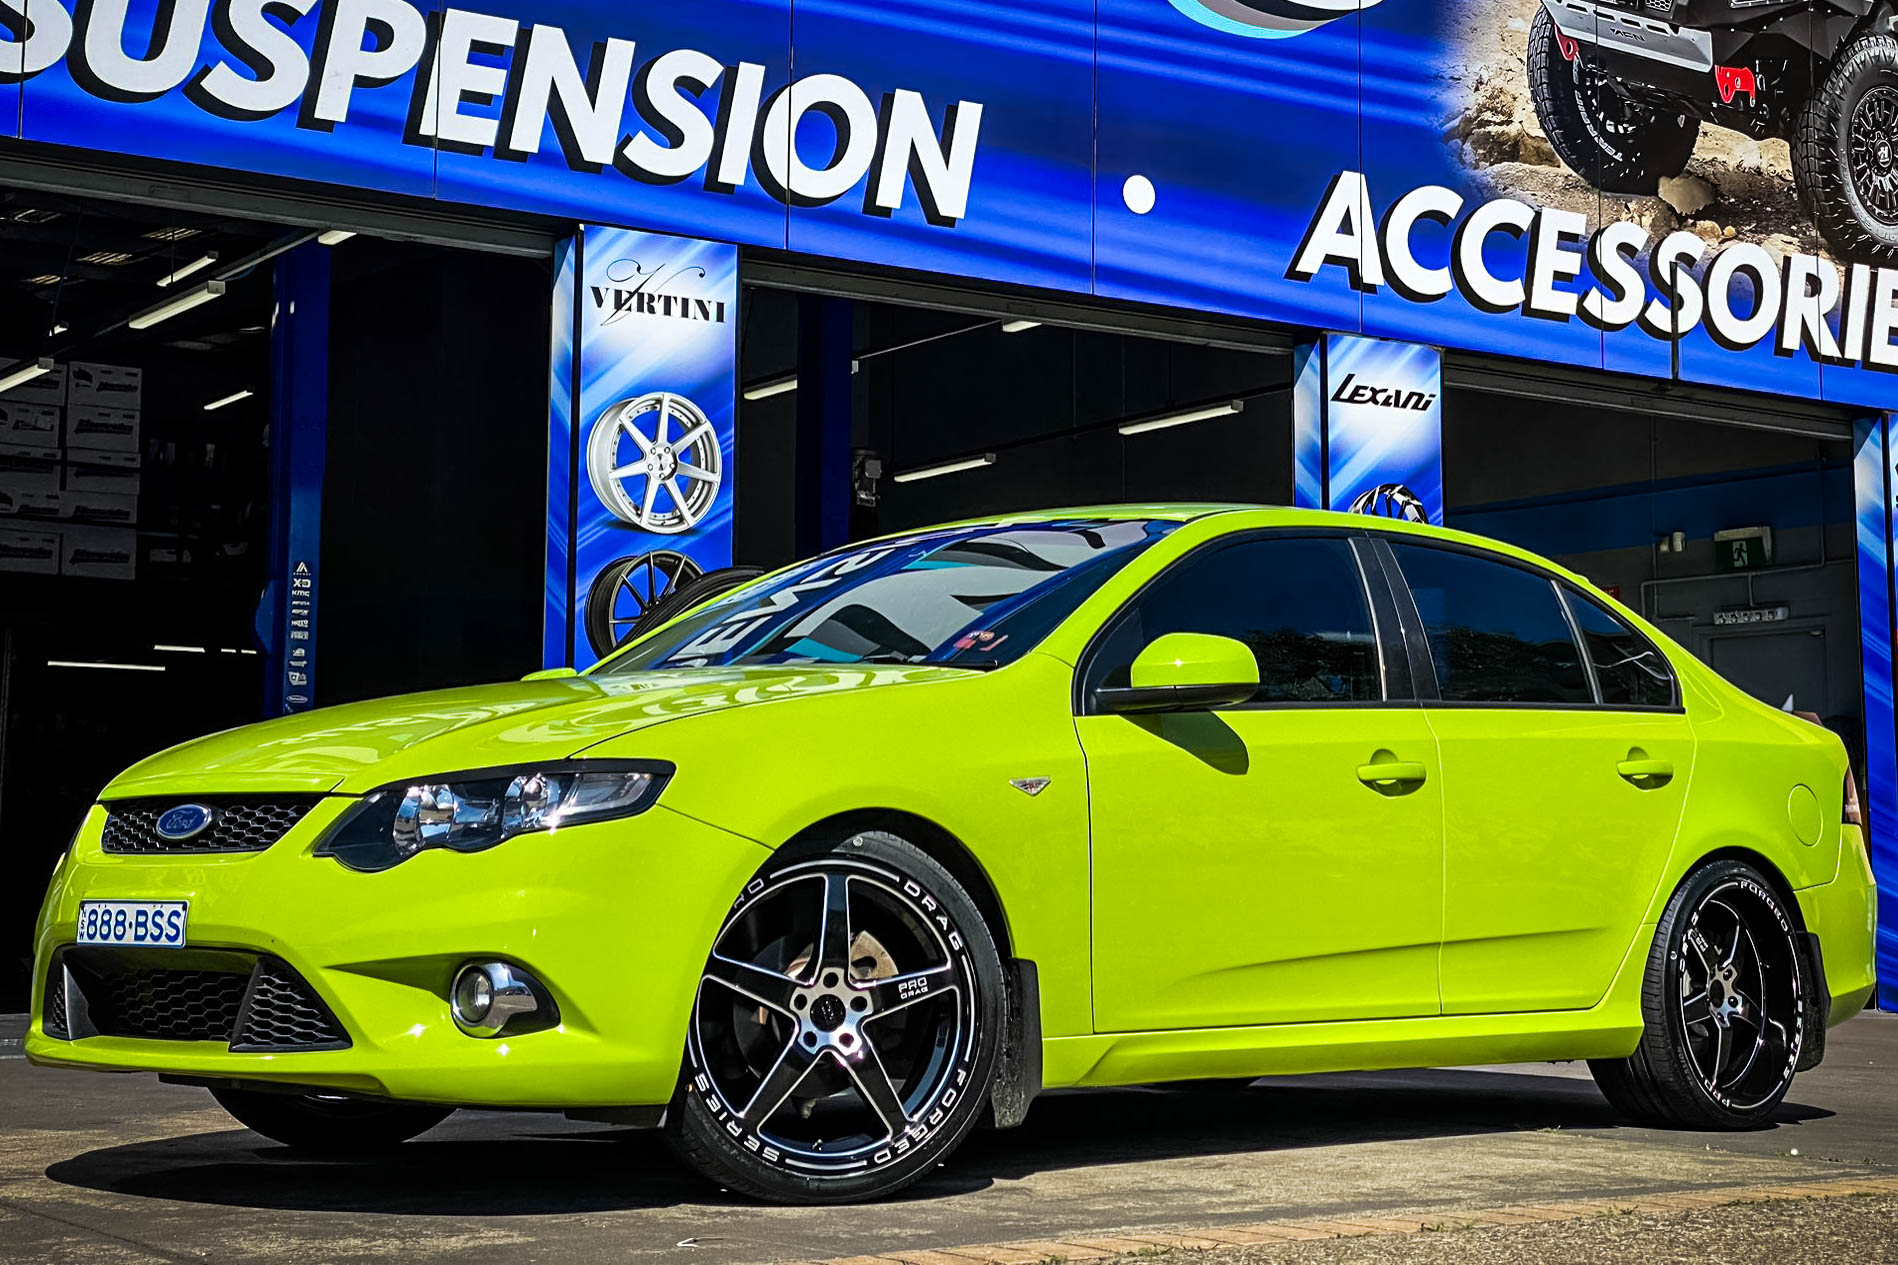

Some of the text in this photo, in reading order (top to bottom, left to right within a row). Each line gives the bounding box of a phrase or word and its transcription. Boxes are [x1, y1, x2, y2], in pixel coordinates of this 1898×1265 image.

[1294, 170, 1898, 367] ACCESSORIE
[590, 285, 726, 324] VERTINI
[903, 880, 964, 952] DRAG
[1740, 880, 1789, 933] FORGED
[898, 976, 928, 993] PRO
[900, 986, 929, 1000] DRAG
[693, 1072, 780, 1163] SERIES
[873, 1067, 967, 1166] FORGED
